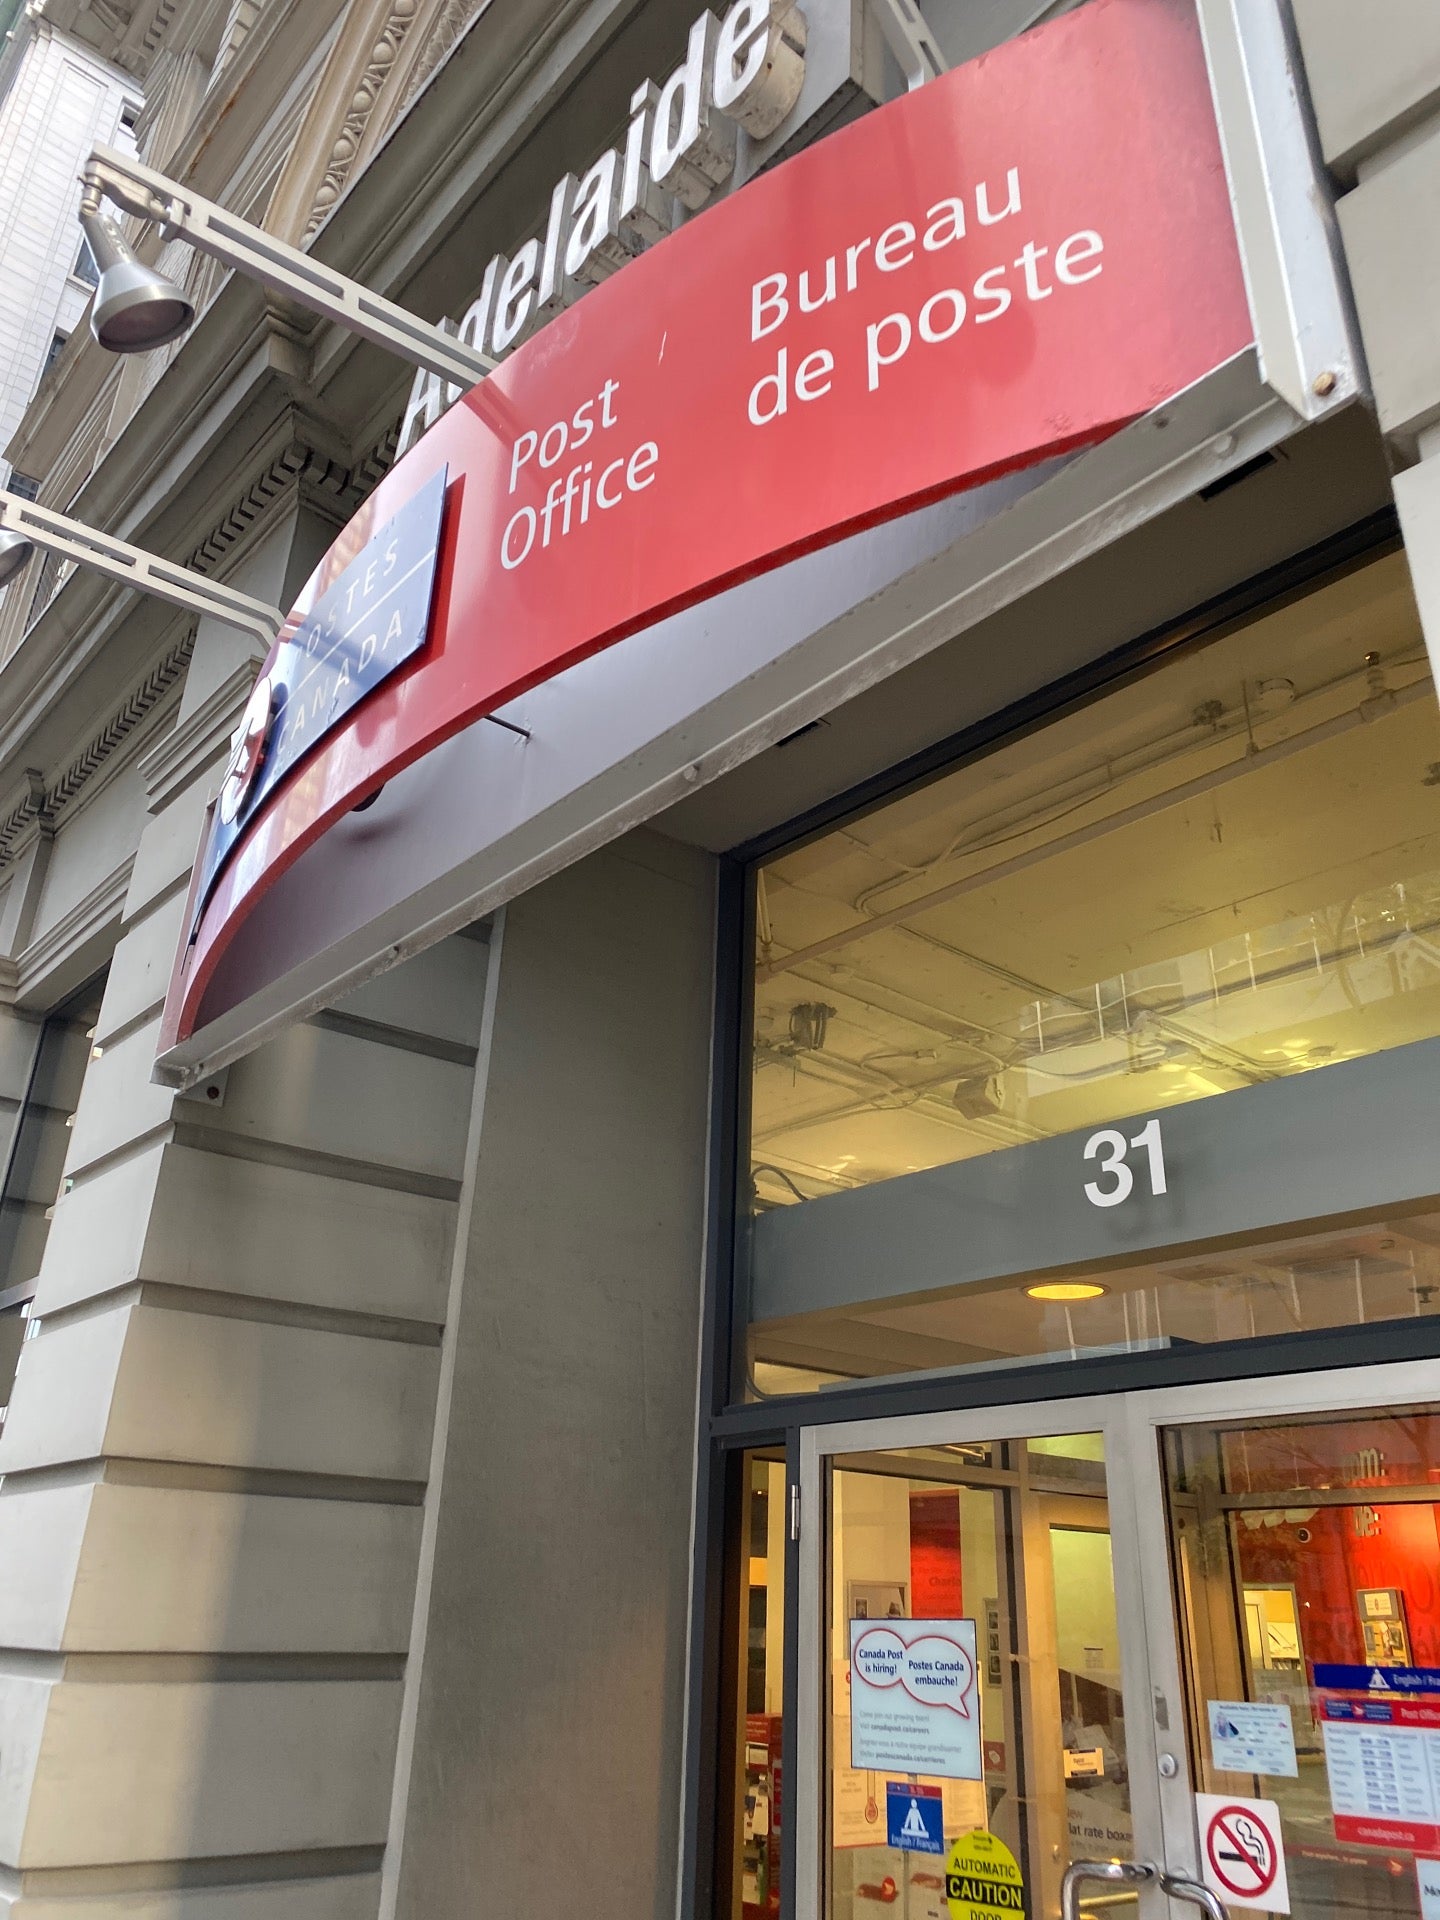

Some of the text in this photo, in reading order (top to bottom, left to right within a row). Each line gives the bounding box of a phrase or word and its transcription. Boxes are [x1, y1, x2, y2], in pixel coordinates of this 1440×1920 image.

[750, 166, 1023, 343] Bureau
[747, 228, 1104, 426] de poste
[509, 378, 620, 495] Post
[501, 441, 659, 570] Office
[296, 537, 399, 668] OSTES
[277, 608, 403, 755] CANADA
[1083, 1118, 1167, 1208] 31
[859, 1649, 904, 1660] Canada Post
[865, 1664, 897, 1677] is hiring!
[908, 1660, 965, 1672] Postes Canada
[914, 1675, 959, 1687] embauche!
[1083, 1827, 1104, 1839] rate
[950, 1876, 1022, 1908] CAUTION
[953, 1856, 1016, 1879] AUTOMATIC
